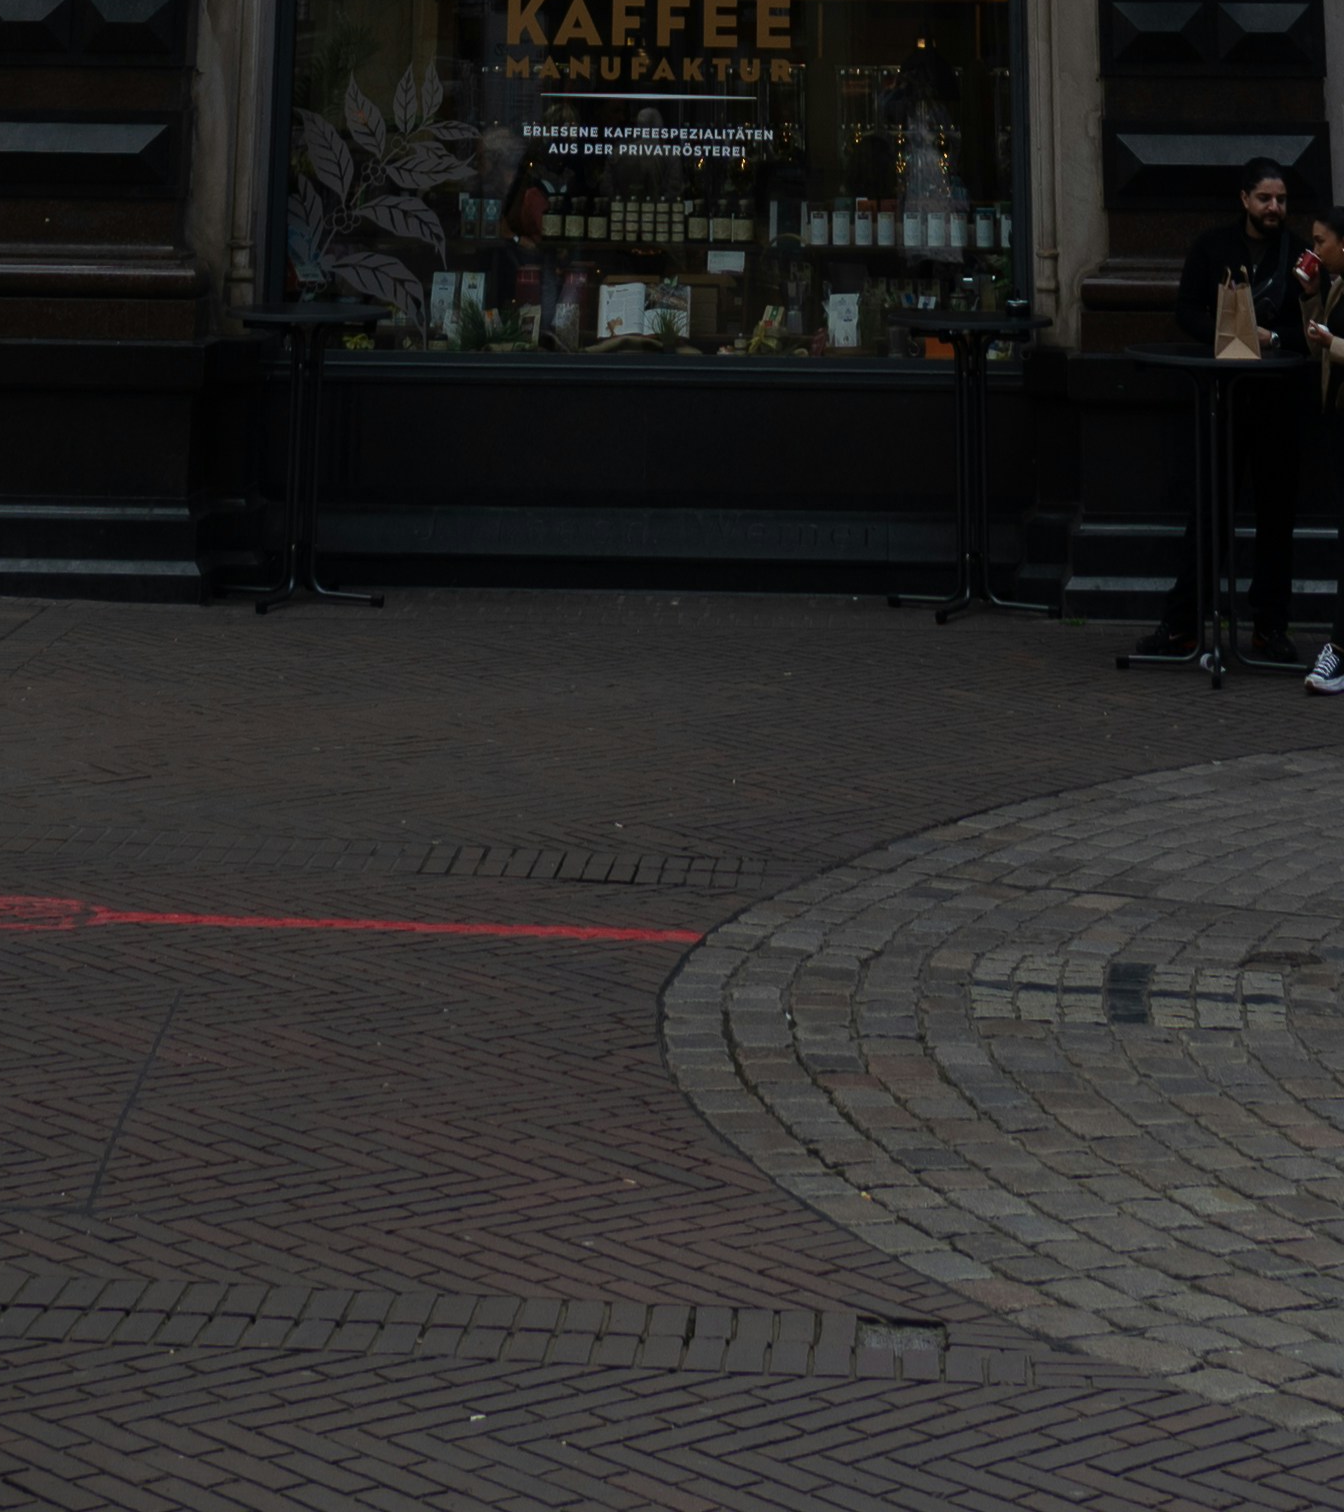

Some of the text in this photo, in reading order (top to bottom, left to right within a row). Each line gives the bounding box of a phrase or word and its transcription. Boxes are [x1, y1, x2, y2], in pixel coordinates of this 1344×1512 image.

[506, 55, 793, 83] MANUFAKTUR
[522, 124, 774, 141] ERLESENE KAFFEESPEZIALITÄTEN
[548, 142, 746, 158] AUS DER PRIVATRÖSTEREI
